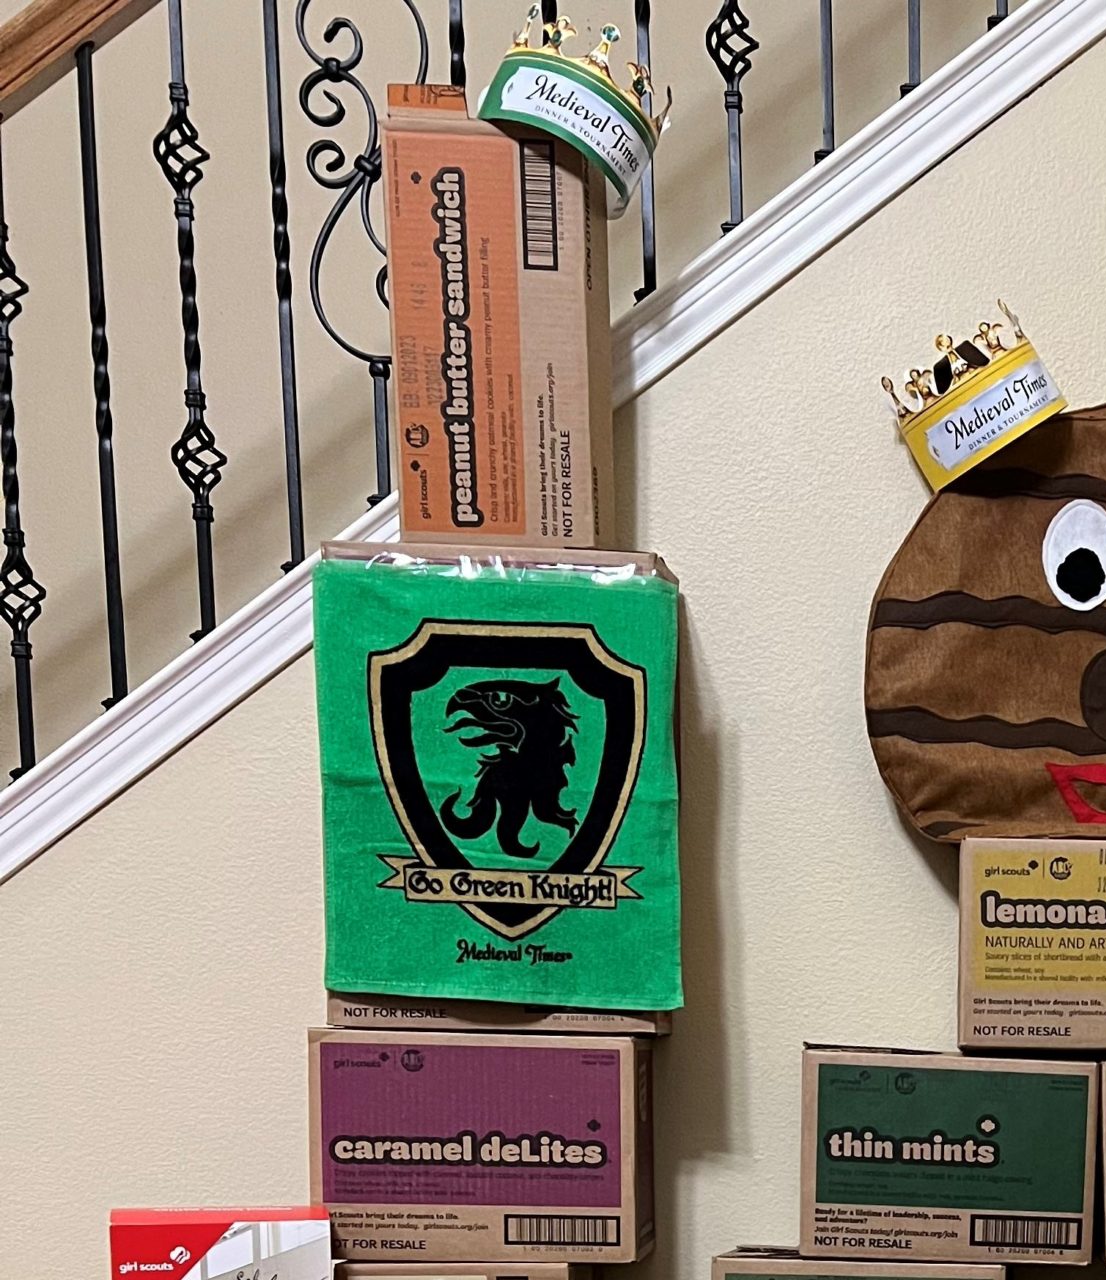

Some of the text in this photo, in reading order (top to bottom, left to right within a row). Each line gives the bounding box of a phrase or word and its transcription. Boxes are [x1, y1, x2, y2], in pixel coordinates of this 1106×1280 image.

[525, 74, 640, 173] Medieval Times
[535, 105, 627, 175] DINNER TOURNAMENT
[436, 173, 478, 523] peanut butter sandwich
[944, 373, 1048, 450] Medieval Times
[968, 394, 1049, 450] DINNER TOURNAMENT
[560, 430, 573, 538] NOT FOR RESALE
[407, 871, 613, 905] Go Green Knight!
[984, 866, 1030, 878] girl scouts
[456, 938, 572, 966] Medieval Times
[985, 936, 1054, 949] NATURALLY
[1058, 937, 1085, 950] AND
[343, 1007, 448, 1019] NOT FOR RESALE
[973, 1025, 1072, 1037] NOT FOR RESALE
[333, 1135, 603, 1165] caramel deLites
[829, 1131, 996, 1165] thin mints
[119, 1261, 173, 1274] girl scouts
